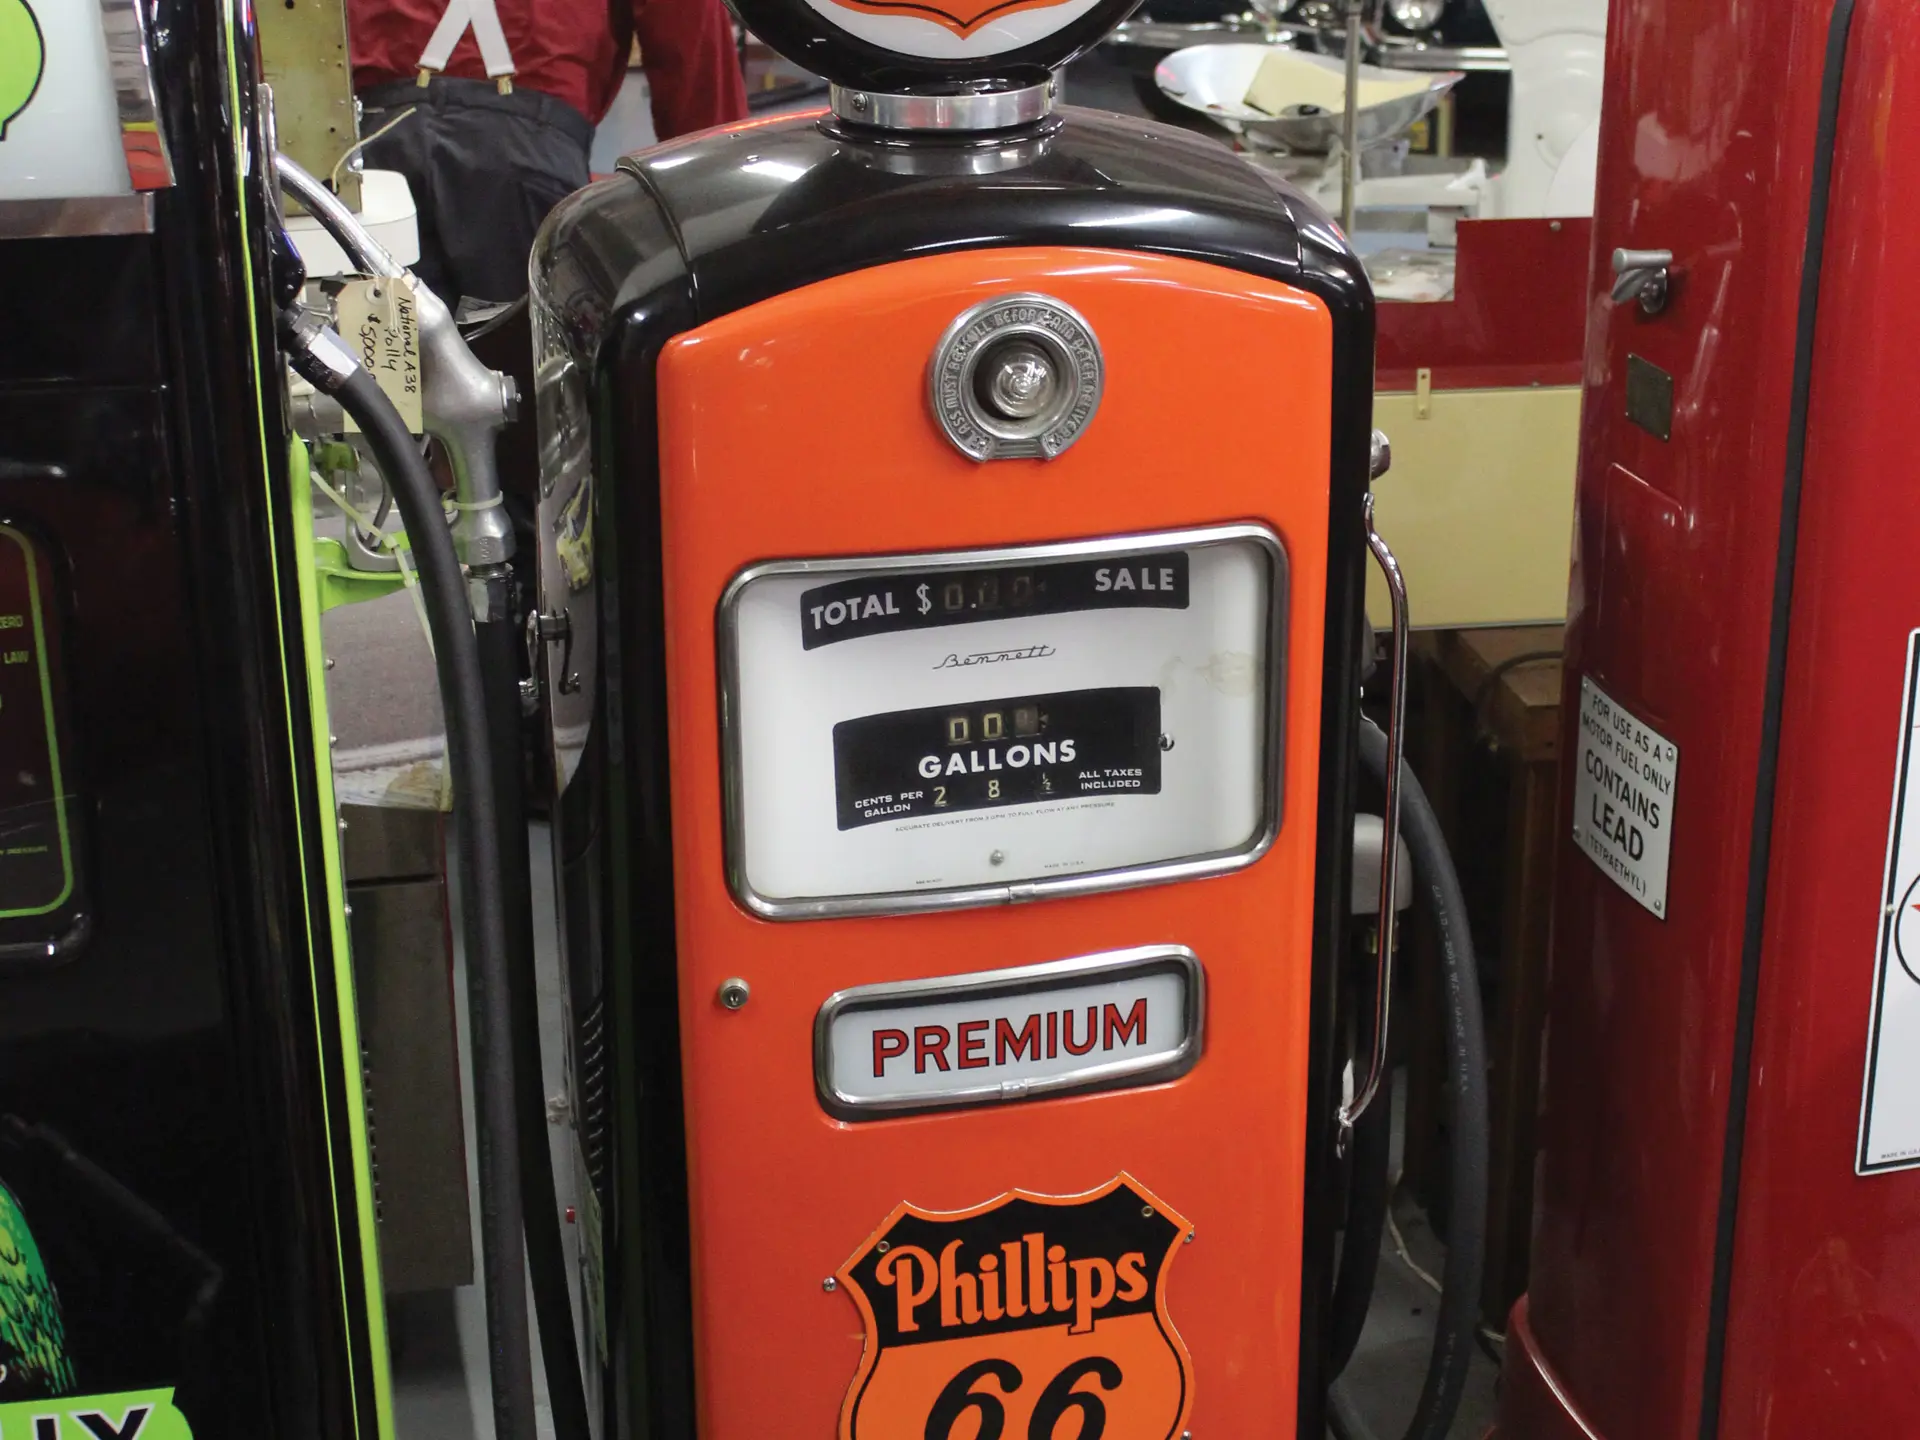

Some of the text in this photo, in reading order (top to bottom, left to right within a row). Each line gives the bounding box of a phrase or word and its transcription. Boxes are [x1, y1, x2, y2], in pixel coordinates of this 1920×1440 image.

[398, 296, 416, 358] National
[963, 320, 995, 351] FULL
[994, 307, 1049, 327] BEFORE
[1049, 315, 1076, 341] AND
[951, 351, 967, 371] BE
[1072, 337, 1097, 383] AFTER
[943, 374, 959, 409] MUST
[1055, 383, 1097, 447] DELIVERY
[810, 592, 900, 630] TOTAL
[916, 583, 932, 614] $
[1094, 567, 1174, 592] SALE
[4, 650, 29, 664] LAW
[932, 645, 1056, 670] Bennett
[1592, 693, 1662, 763] FOR USE AS A
[918, 739, 1077, 779] GALLONS
[1582, 712, 1672, 797] MOTOR FUEL ONLY
[933, 786, 947, 805] 2
[988, 779, 1001, 798] 8
[1078, 768, 1143, 779] ALL TAXES
[1080, 780, 1142, 790] INCLUDED
[1585, 749, 1661, 831] CONTAINS
[854, 790, 924, 809] CENTS PER
[864, 803, 911, 818] GALLON
[895, 823, 931, 832] ACCURATE
[932, 818, 964, 828] DELIVERY
[1080, 801, 1115, 810] PRESSURE
[1592, 793, 1645, 863] LEAD
[1585, 830, 1648, 898] (TETRAETHYL)
[872, 997, 1148, 1078] PREMIUM
[875, 1232, 1149, 1334] Phillips
[924, 1356, 1123, 1440] 66
